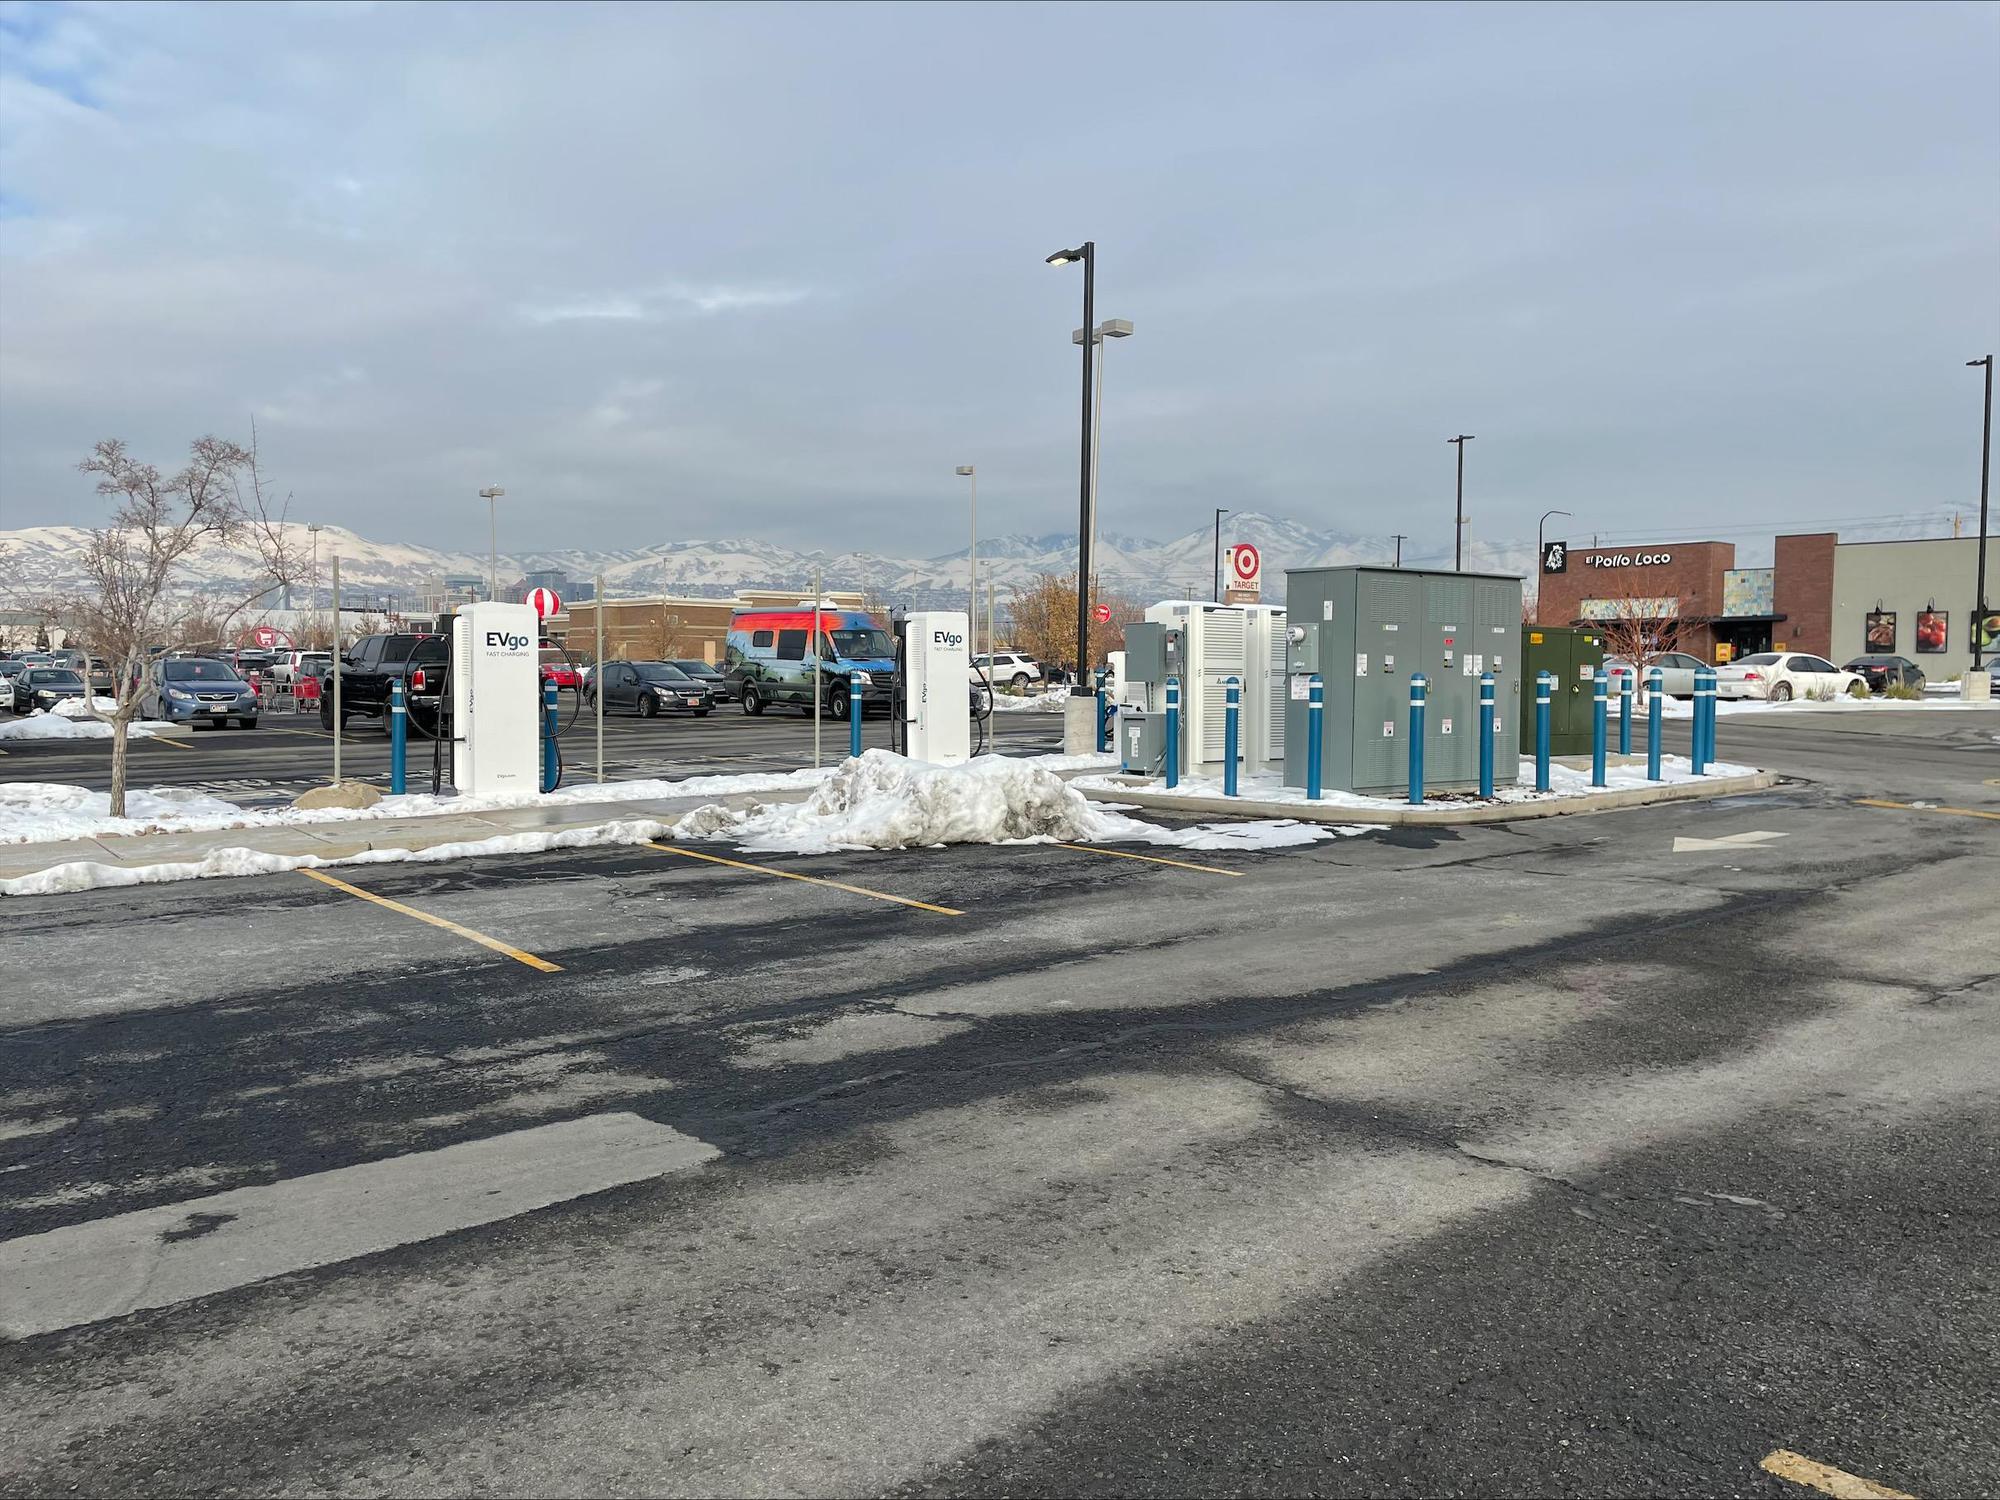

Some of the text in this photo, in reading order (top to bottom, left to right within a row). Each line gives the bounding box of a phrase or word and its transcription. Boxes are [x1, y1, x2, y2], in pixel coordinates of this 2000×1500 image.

[1585, 552, 1671, 568] El Pollo Loco
[1233, 581, 1259, 589] TARGET
[486, 632, 529, 650] EVgo
[934, 631, 962, 646] EVgo
